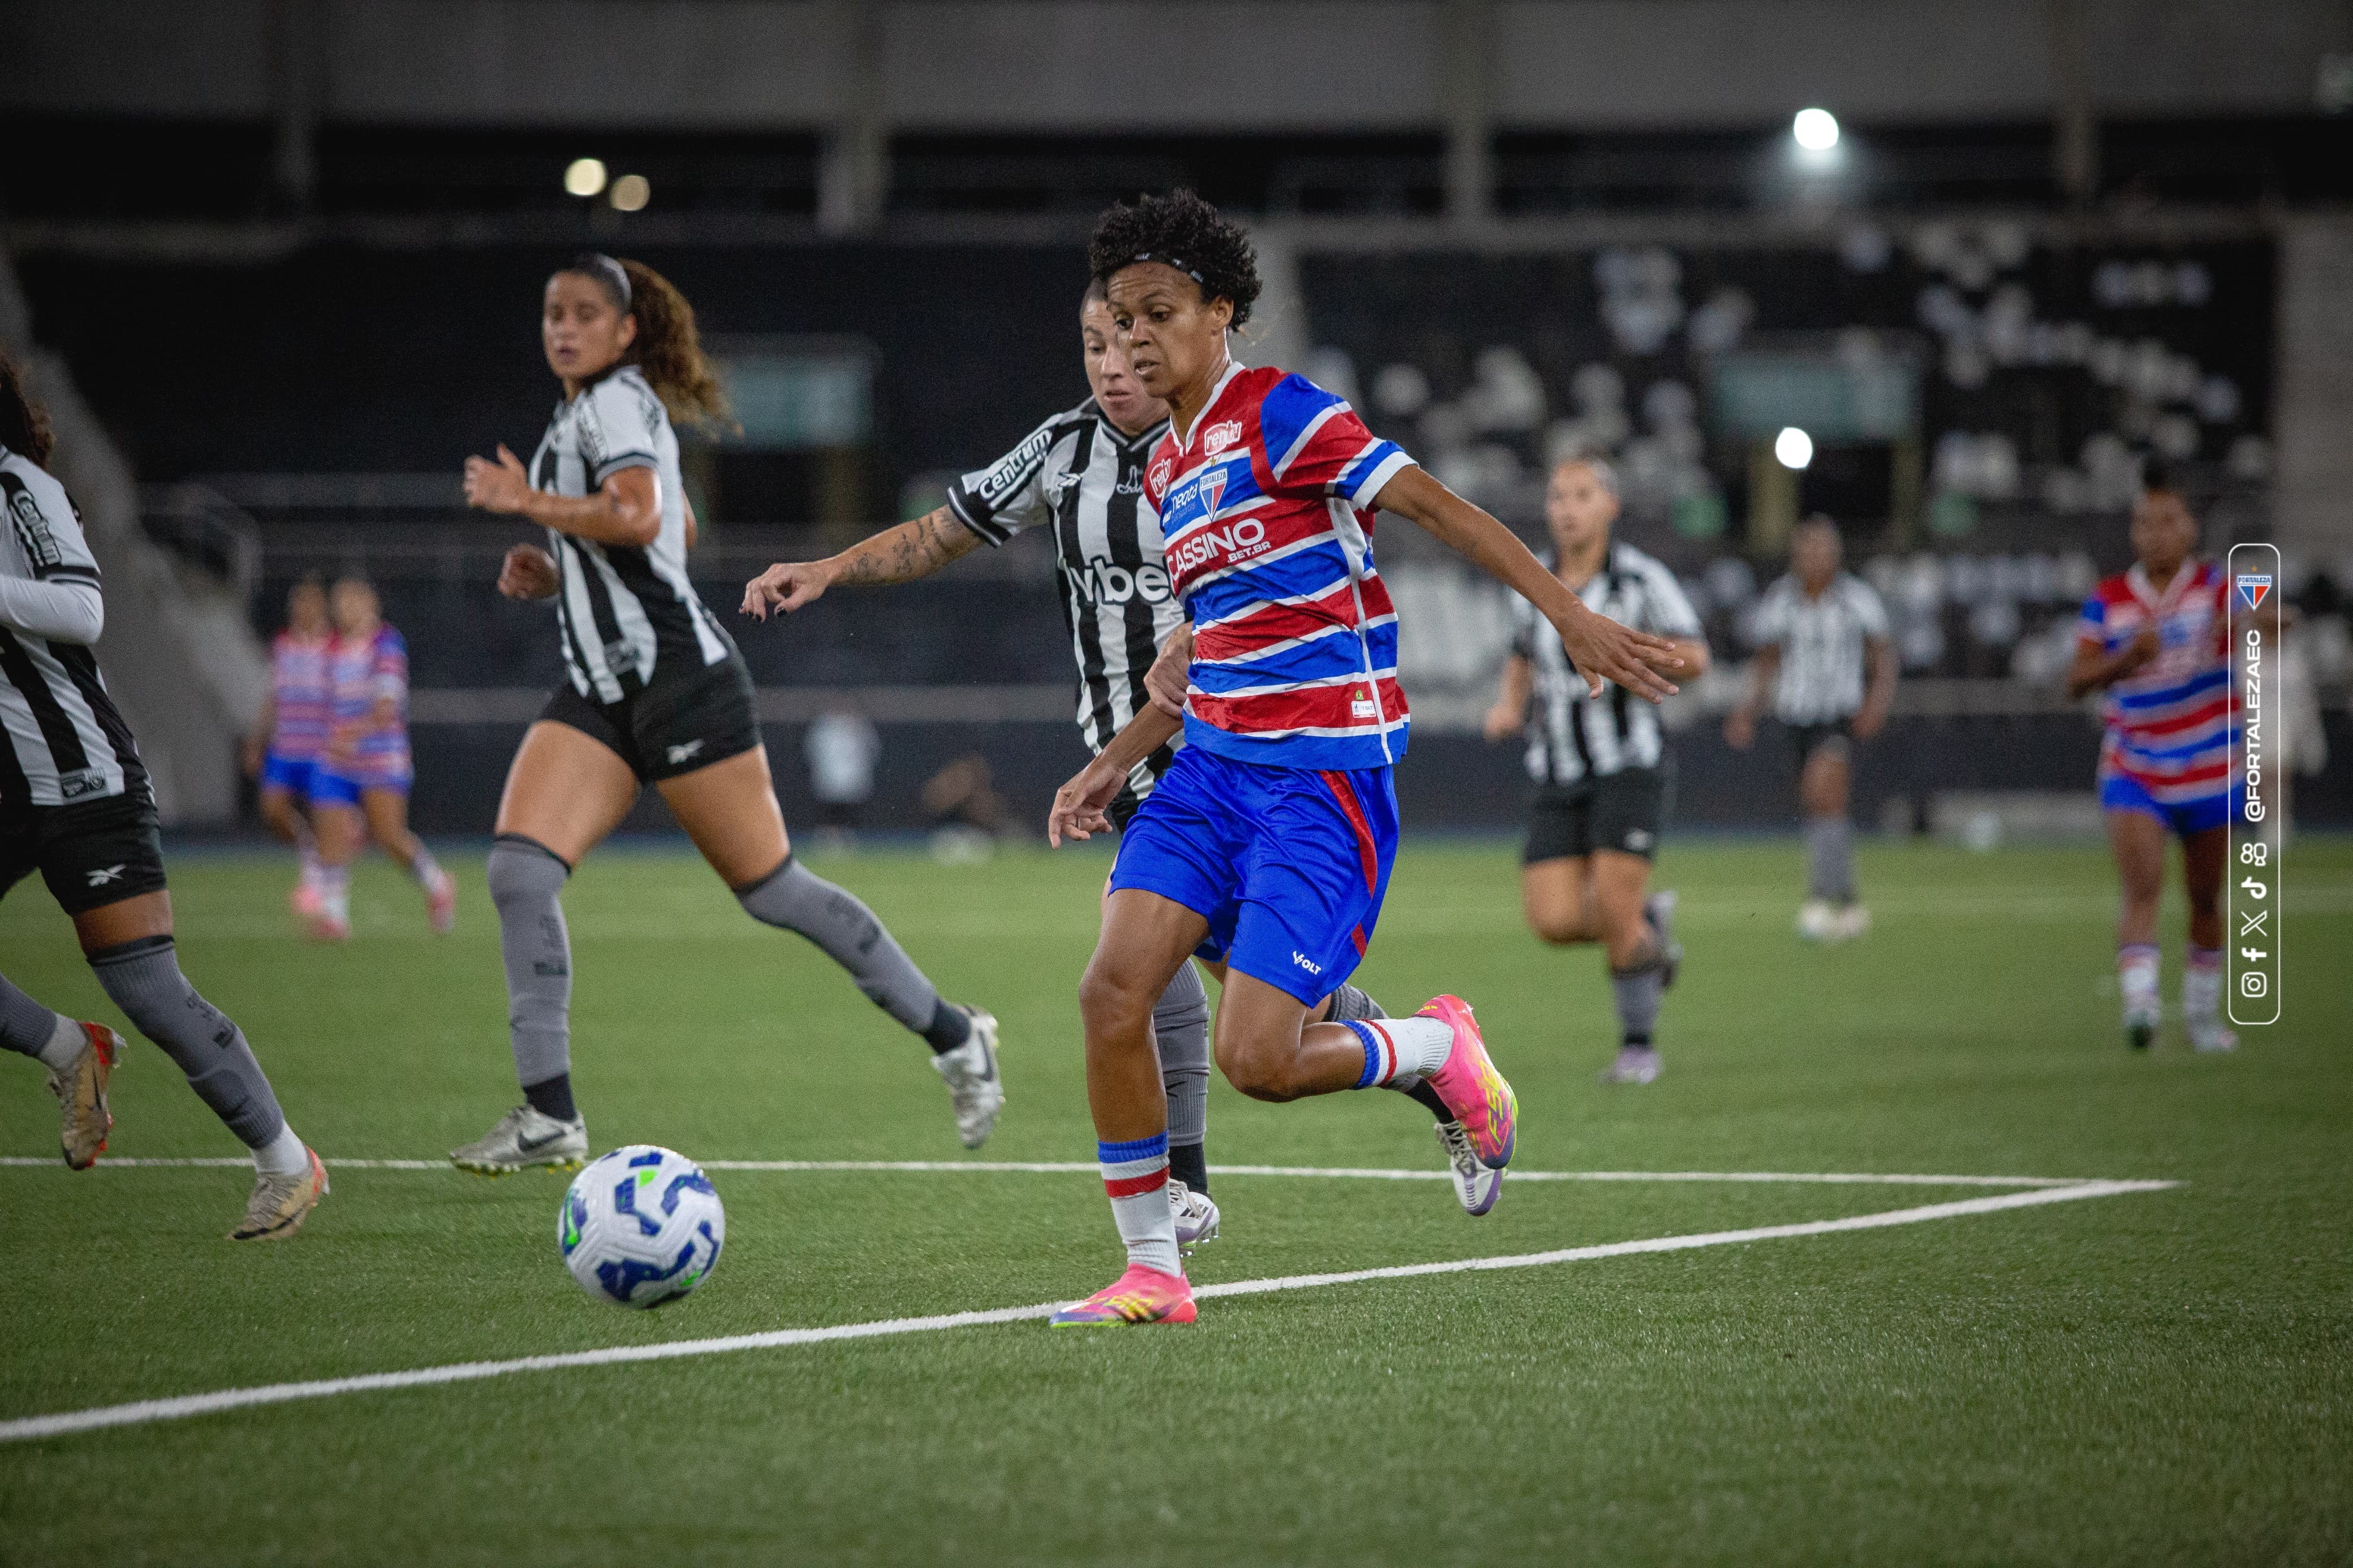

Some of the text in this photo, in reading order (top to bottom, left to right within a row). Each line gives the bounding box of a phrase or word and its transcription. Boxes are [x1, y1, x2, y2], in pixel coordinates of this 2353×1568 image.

[979, 429, 1052, 499] Centrum
[1201, 470, 1227, 486] FORTALEZA
[1166, 518, 1265, 581] CASSINO
[1069, 557, 1170, 603] vbe
[1292, 951, 1322, 975] VOLT
